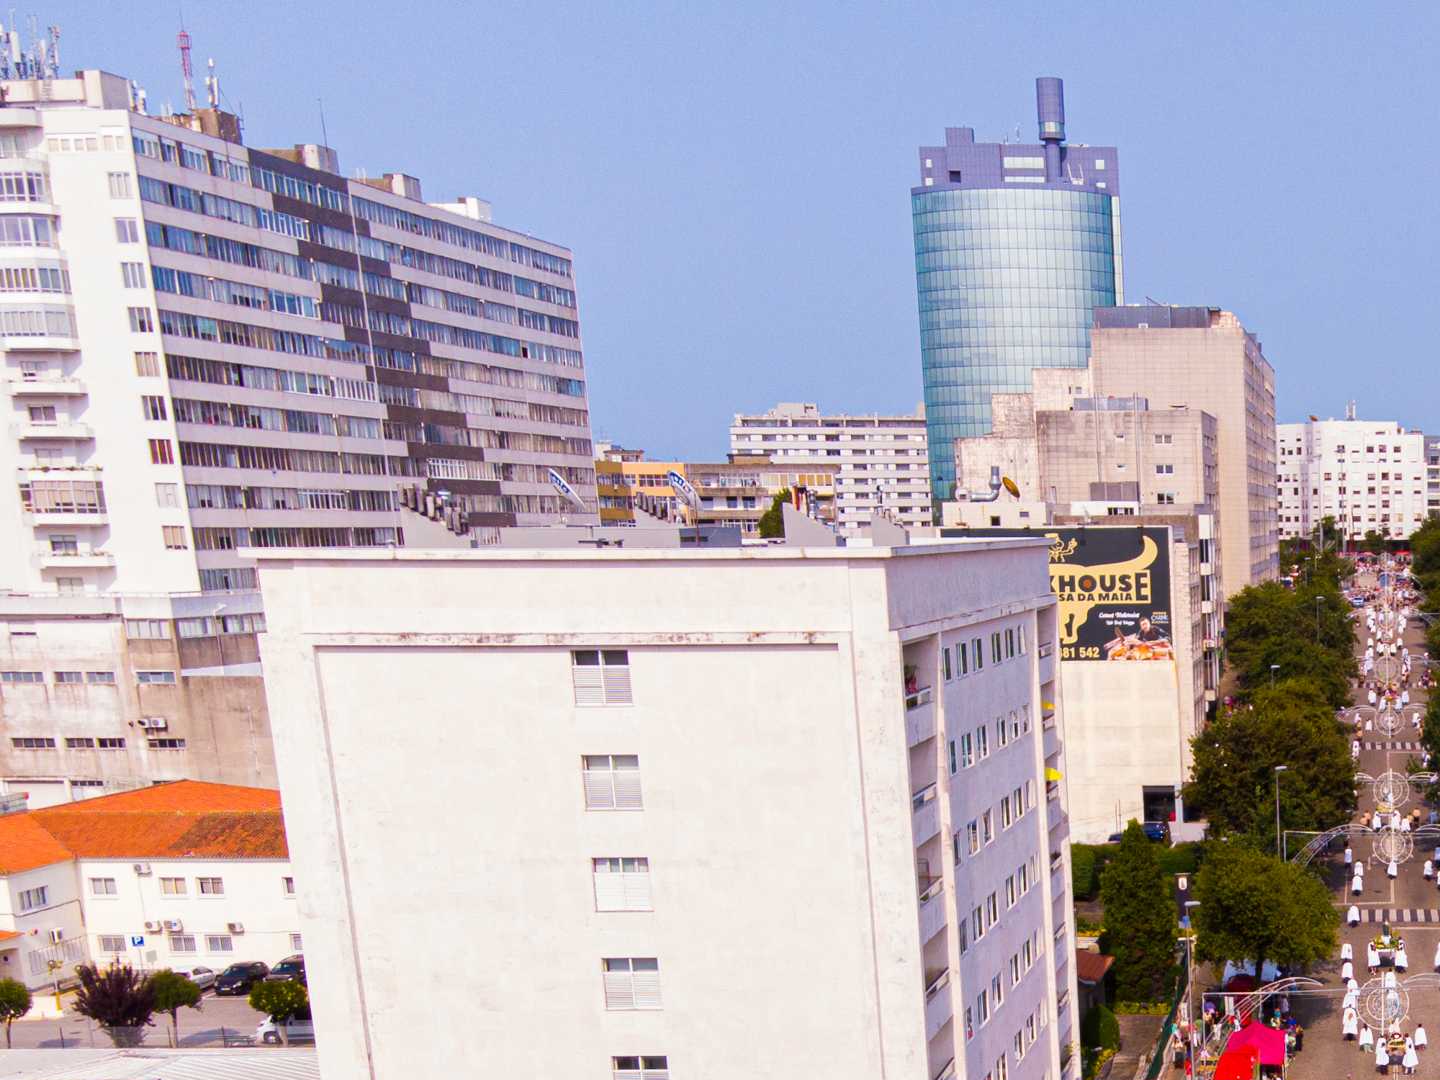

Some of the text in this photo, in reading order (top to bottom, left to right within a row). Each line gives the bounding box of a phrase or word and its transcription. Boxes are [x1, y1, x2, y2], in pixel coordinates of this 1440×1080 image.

[1077, 593, 1095, 601] DA
[1098, 593, 1132, 601] MAIA
[1079, 646, 1100, 658] 542
